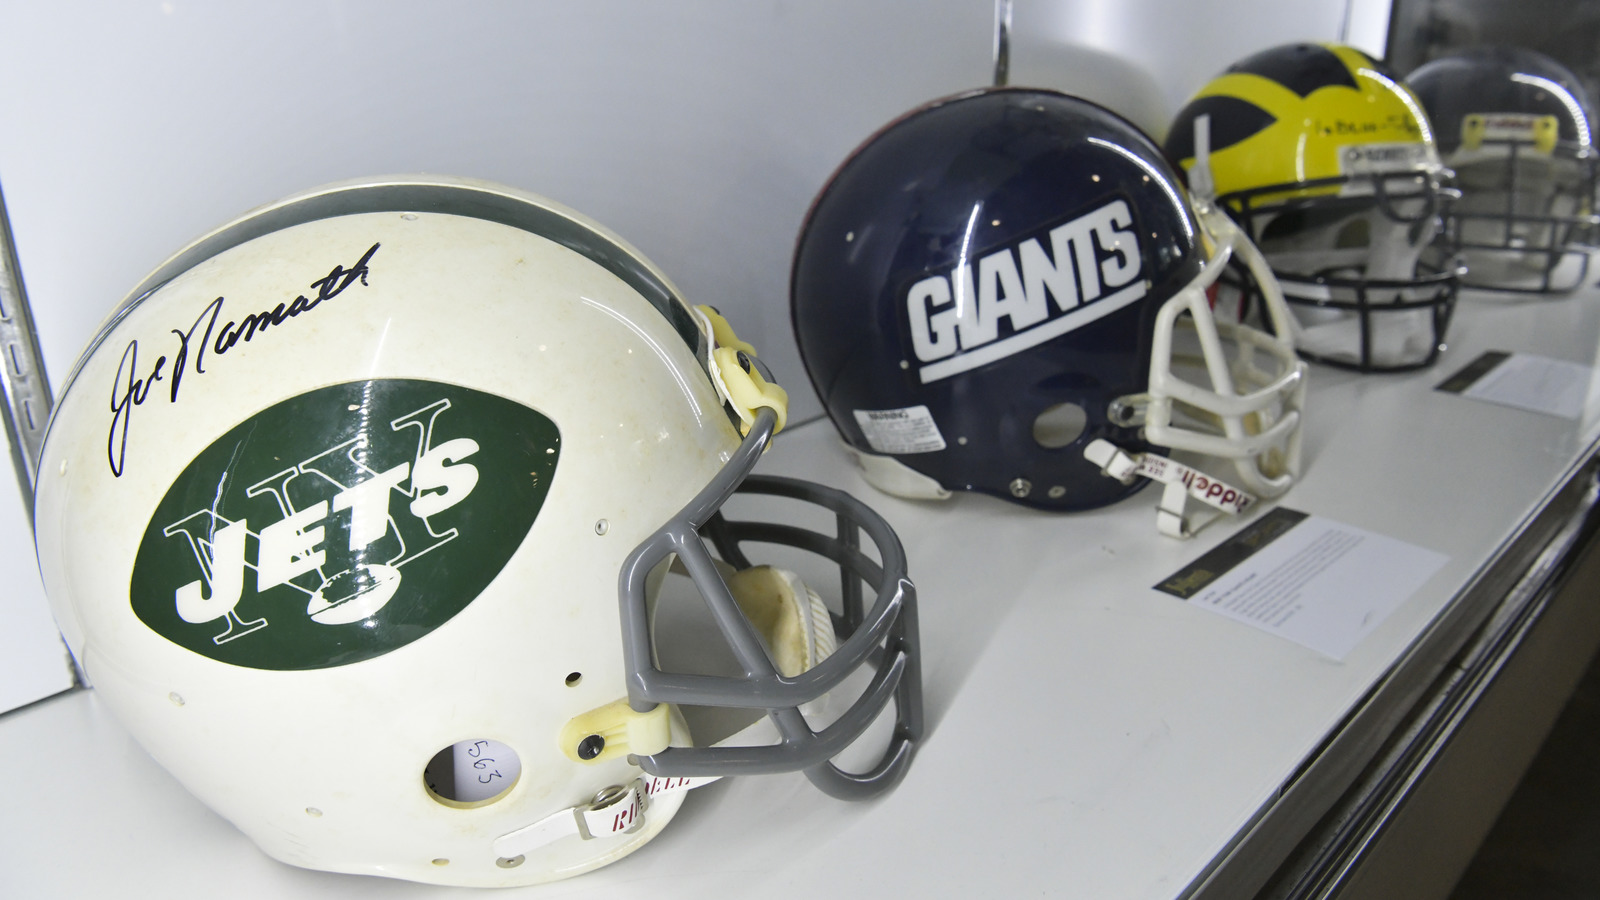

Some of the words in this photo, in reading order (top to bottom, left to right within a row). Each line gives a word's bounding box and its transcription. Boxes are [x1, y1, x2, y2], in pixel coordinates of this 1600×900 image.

[108, 339, 166, 478] Joe
[171, 242, 381, 403] Namath
[907, 199, 1141, 362] GIANTS
[176, 438, 480, 624] JETS
[467, 740, 502, 784] 563
